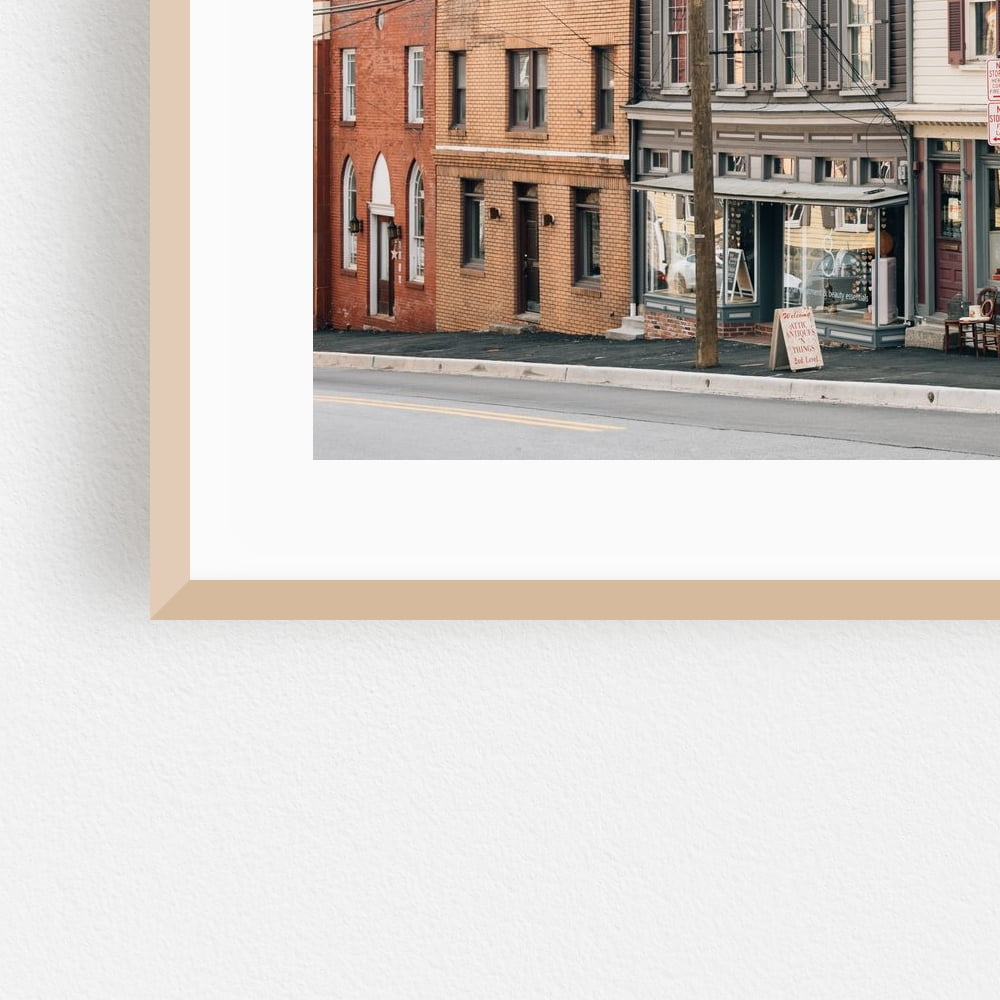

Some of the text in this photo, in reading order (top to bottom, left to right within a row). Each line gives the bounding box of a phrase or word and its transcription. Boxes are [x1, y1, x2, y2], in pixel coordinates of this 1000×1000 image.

[829, 290, 845, 301] beauty
[845, 293, 869, 302] essentials
[782, 312, 811, 320] Welcome
[792, 345, 816, 354] THINGS
